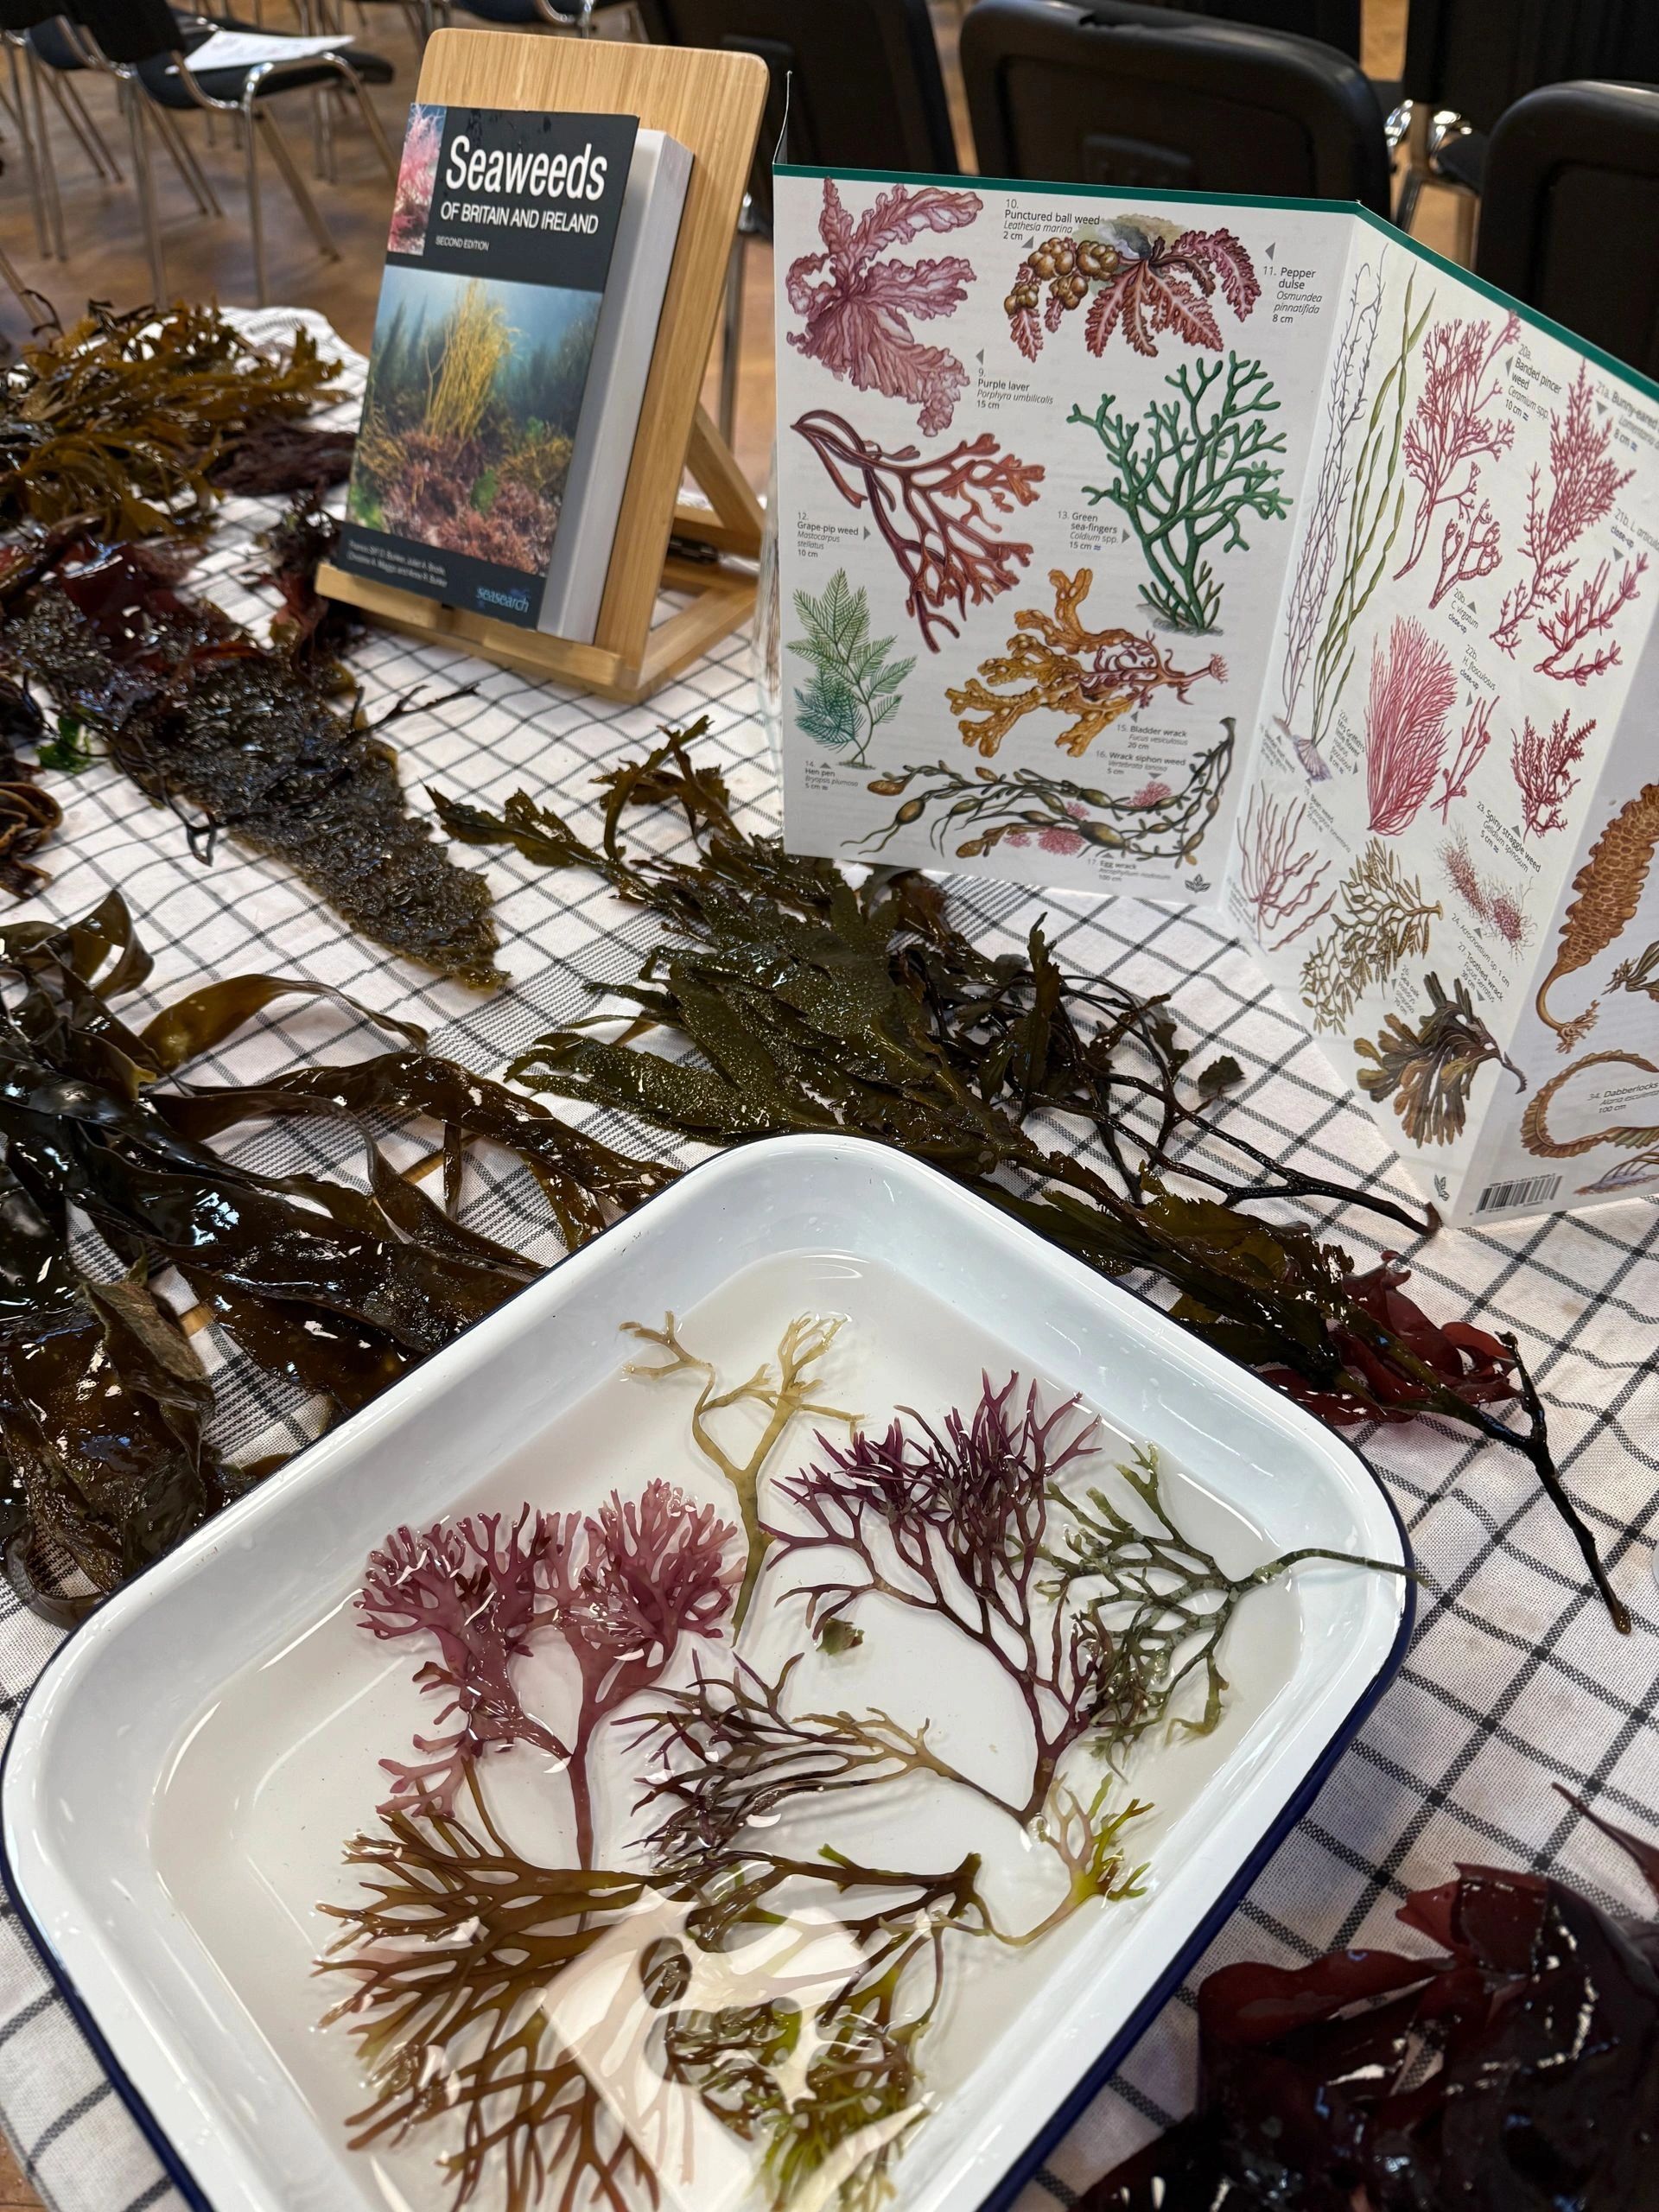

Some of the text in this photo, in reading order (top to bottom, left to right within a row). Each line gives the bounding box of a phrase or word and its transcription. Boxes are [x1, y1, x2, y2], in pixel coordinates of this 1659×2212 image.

[446, 136, 607, 200] Seaweeds
[1006, 199, 1019, 208] 10.
[441, 201, 599, 234] OF BRITAIN AND IRELAND
[1005, 209, 1100, 225] Punctured ball weed
[1004, 221, 1072, 233] Leathesia marina
[435, 236, 489, 251] SECOND EDITION
[1264, 266, 1316, 279] 11. Pepper
[1279, 279, 1305, 289] dulse
[1277, 291, 1322, 302] Osmundea
[1274, 302, 1319, 315] pinnatifida
[1518, 344, 1531, 360] 20a.
[978, 368, 985, 377] 9.
[1516, 357, 1561, 394] Banded pincer
[978, 378, 1030, 391] Purple laver
[1512, 372, 1529, 390] weed
[977, 389, 1053, 404] Porphyra umbilicalis
[1509, 385, 1536, 410] Ceramium
[1505, 399, 1522, 416] 10 cm
[1072, 512, 1097, 522] Green
[798, 521, 859, 536] Grape-pip weed
[1071, 523, 1117, 534] sea-fingers
[1071, 531, 1100, 541] Coldium
[798, 531, 840, 543] Mastocarpus
[798, 541, 824, 550] stellatus
[476, 587, 530, 613] seasearch
[1453, 588, 1465, 605] 20b.
[1458, 606, 1478, 629] virgatum
[1465, 644, 1477, 661] 22b.
[1468, 661, 1496, 691] flosculosus
[1130, 726, 1161, 735] Bladder
[1109, 752, 1134, 760] Wrack
[1484, 821, 1529, 873] Gelidium spinosum
[1485, 836, 1493, 847] cm
[1486, 810, 1502, 831] Spiny
[1502, 828, 1524, 855] straggle
[1525, 852, 1541, 873] weed
[1467, 951, 1488, 981] Toothed
[1488, 979, 1503, 1002] wrack
[1502, 976, 1510, 988] cm
[1604, 1083, 1659, 1097] Dabberlocks
